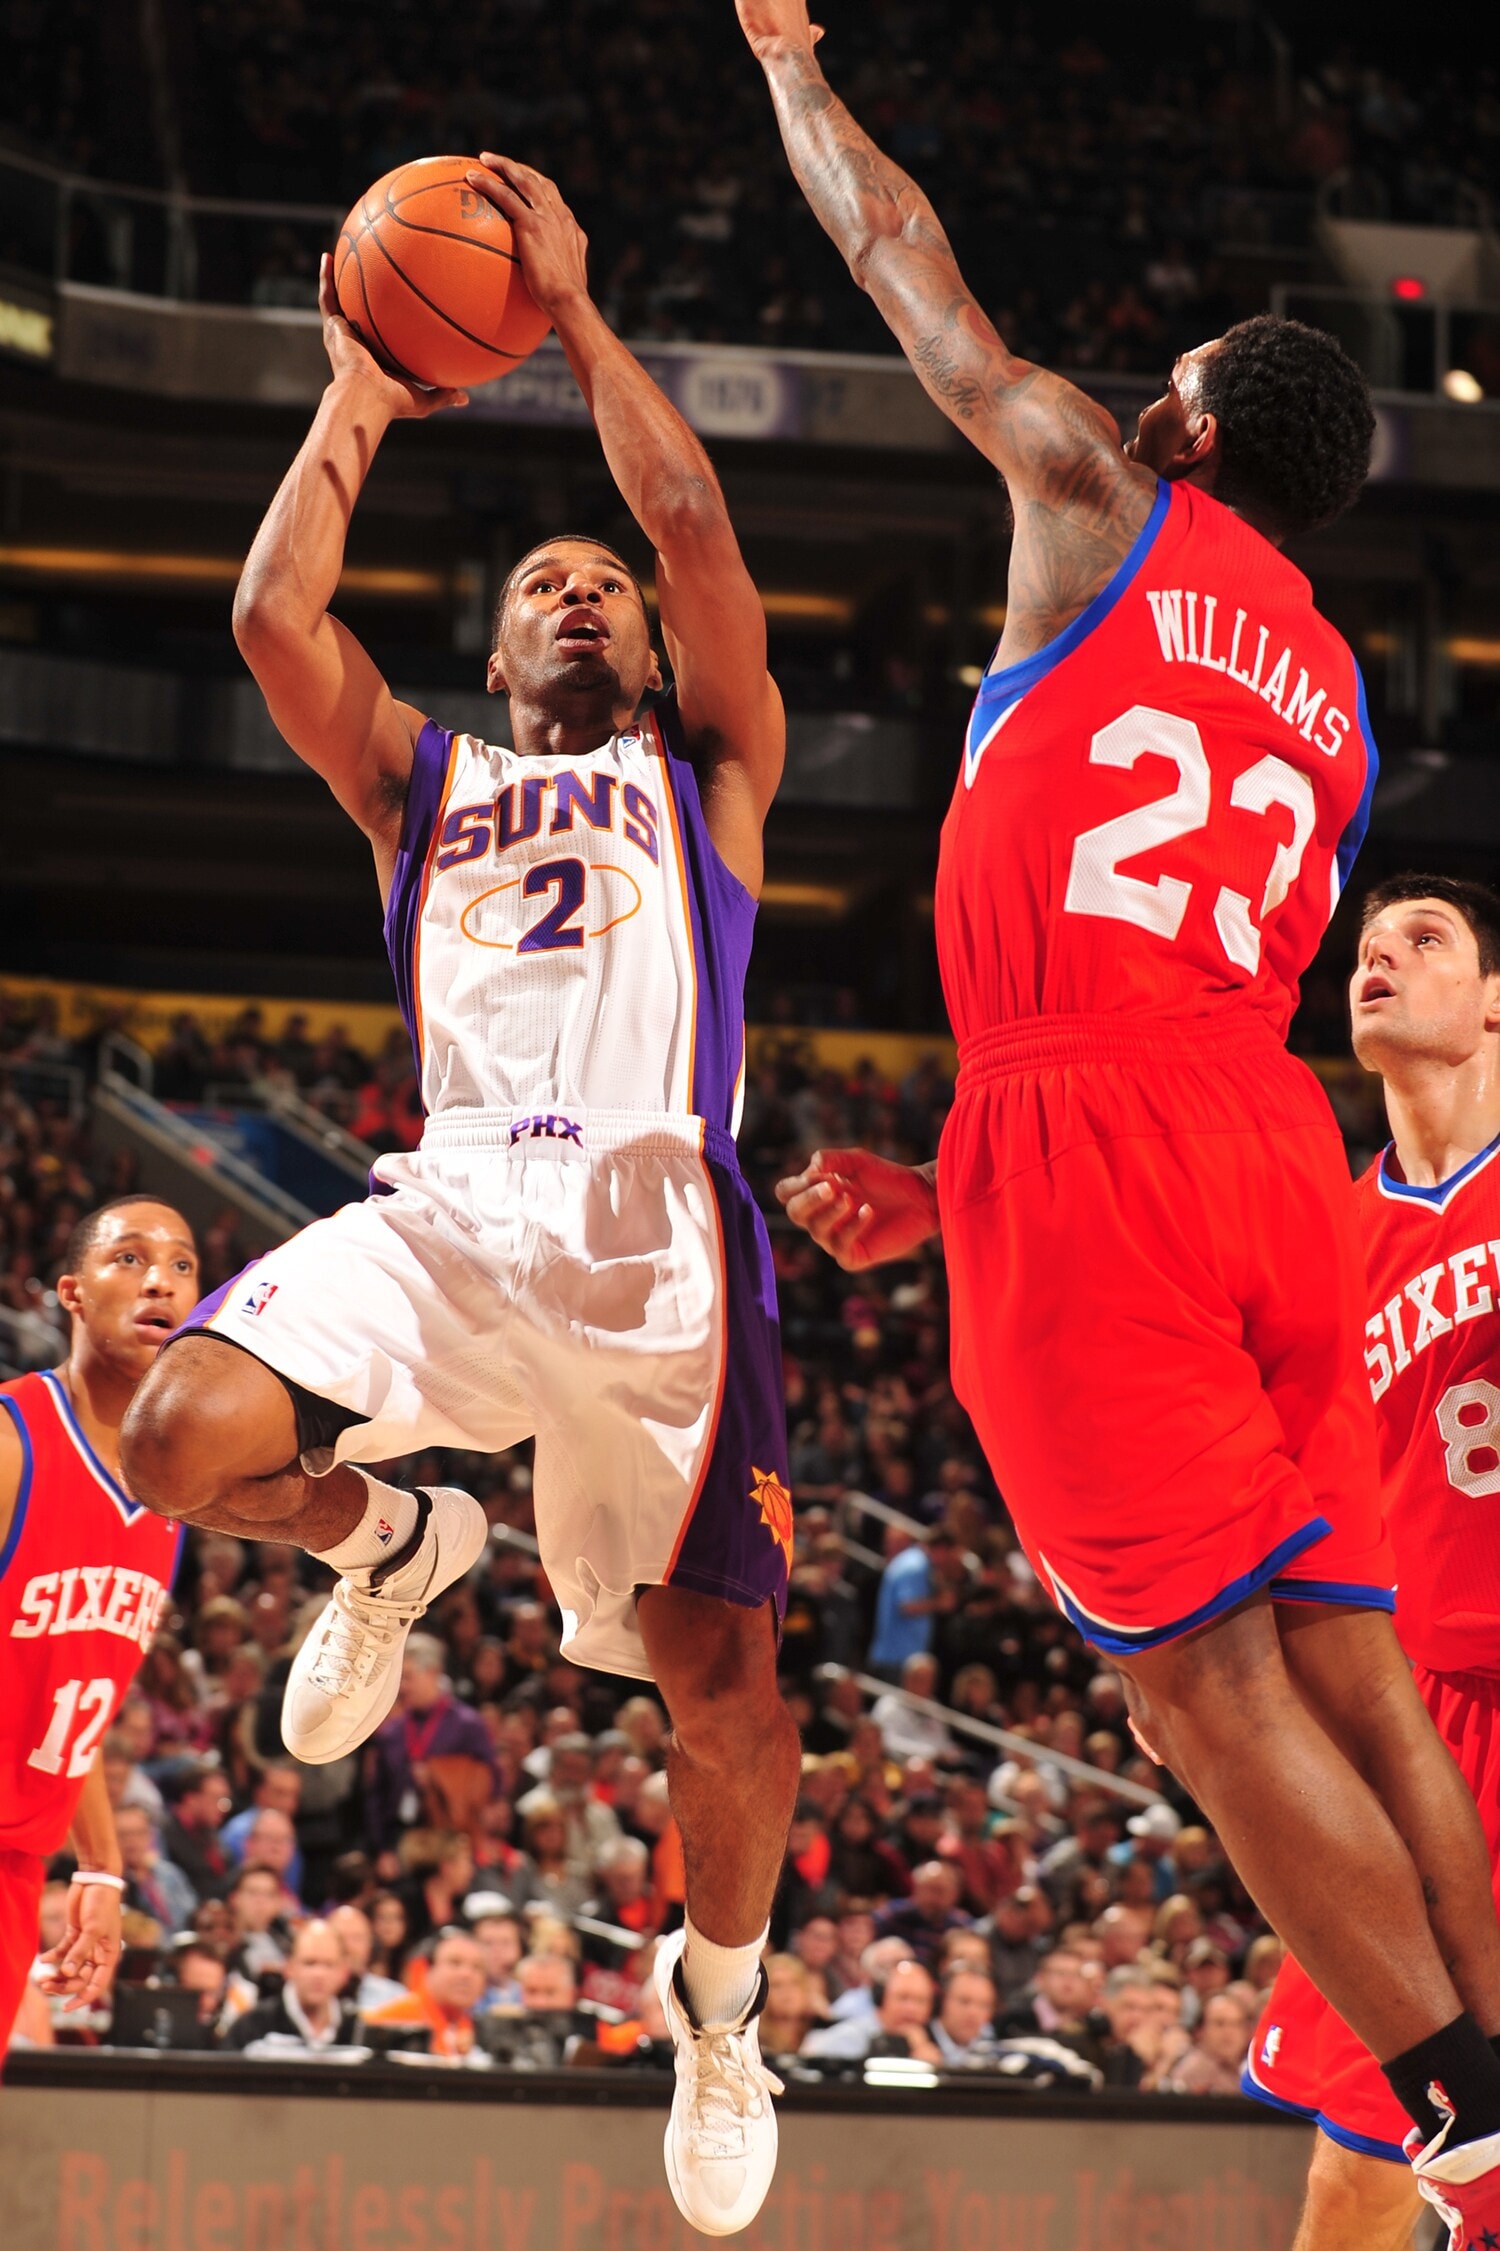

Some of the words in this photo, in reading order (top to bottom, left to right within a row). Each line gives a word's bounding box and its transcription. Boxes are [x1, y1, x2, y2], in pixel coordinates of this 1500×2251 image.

[1146, 589, 1350, 757] WILLIAMS
[435, 768, 659, 877] SUNS
[1064, 704, 1317, 978] 23
[516, 856, 586, 956] 2
[508, 1114, 584, 1149] PHX
[1363, 1239, 1500, 1405] SIXE
[1435, 1378, 1500, 1499] 8
[27, 1678, 115, 1778] 12
[57, 2148, 537, 2251] Relentlessly
[922, 2166, 1056, 2251] Your
